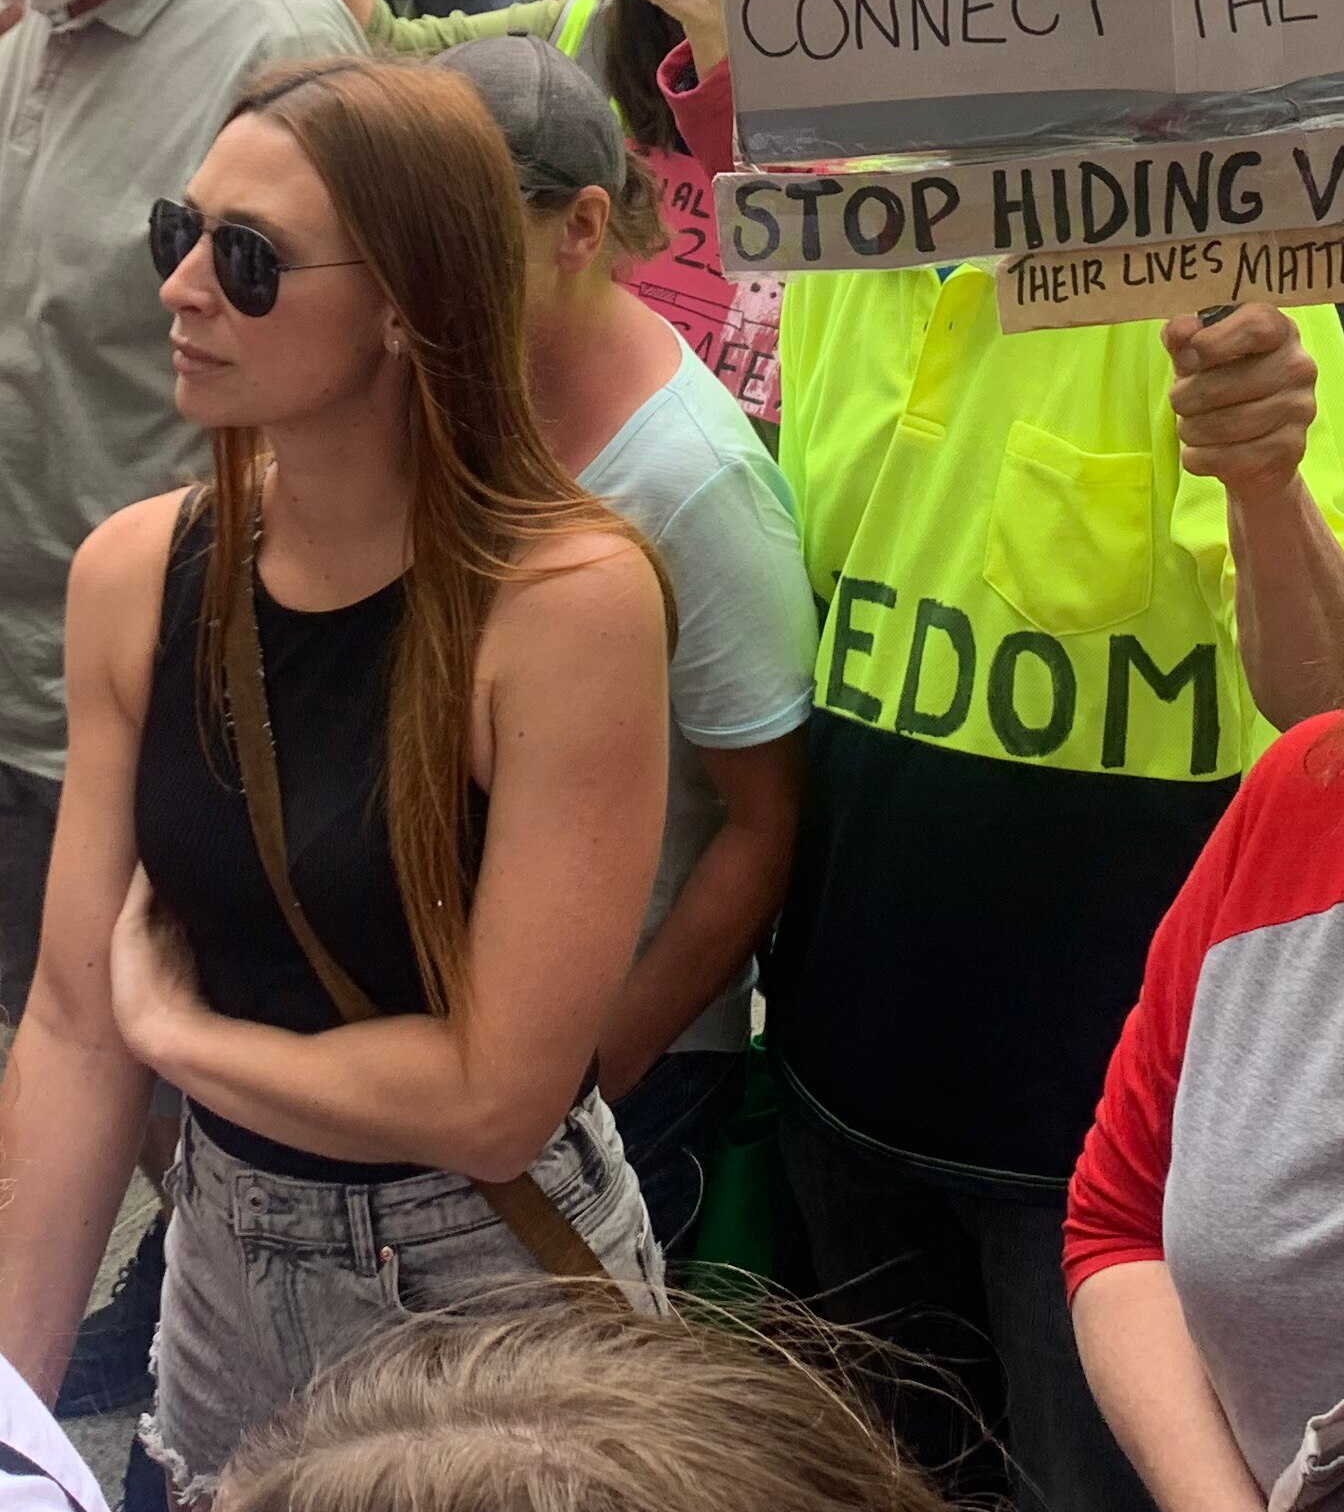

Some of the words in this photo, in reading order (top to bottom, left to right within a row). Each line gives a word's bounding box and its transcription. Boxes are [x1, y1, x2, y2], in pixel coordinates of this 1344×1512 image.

[731, 178, 962, 262] STOP
[991, 149, 1264, 250] HIDING
[1007, 254, 1108, 306] THEIR
[1122, 240, 1224, 288] LIVES
